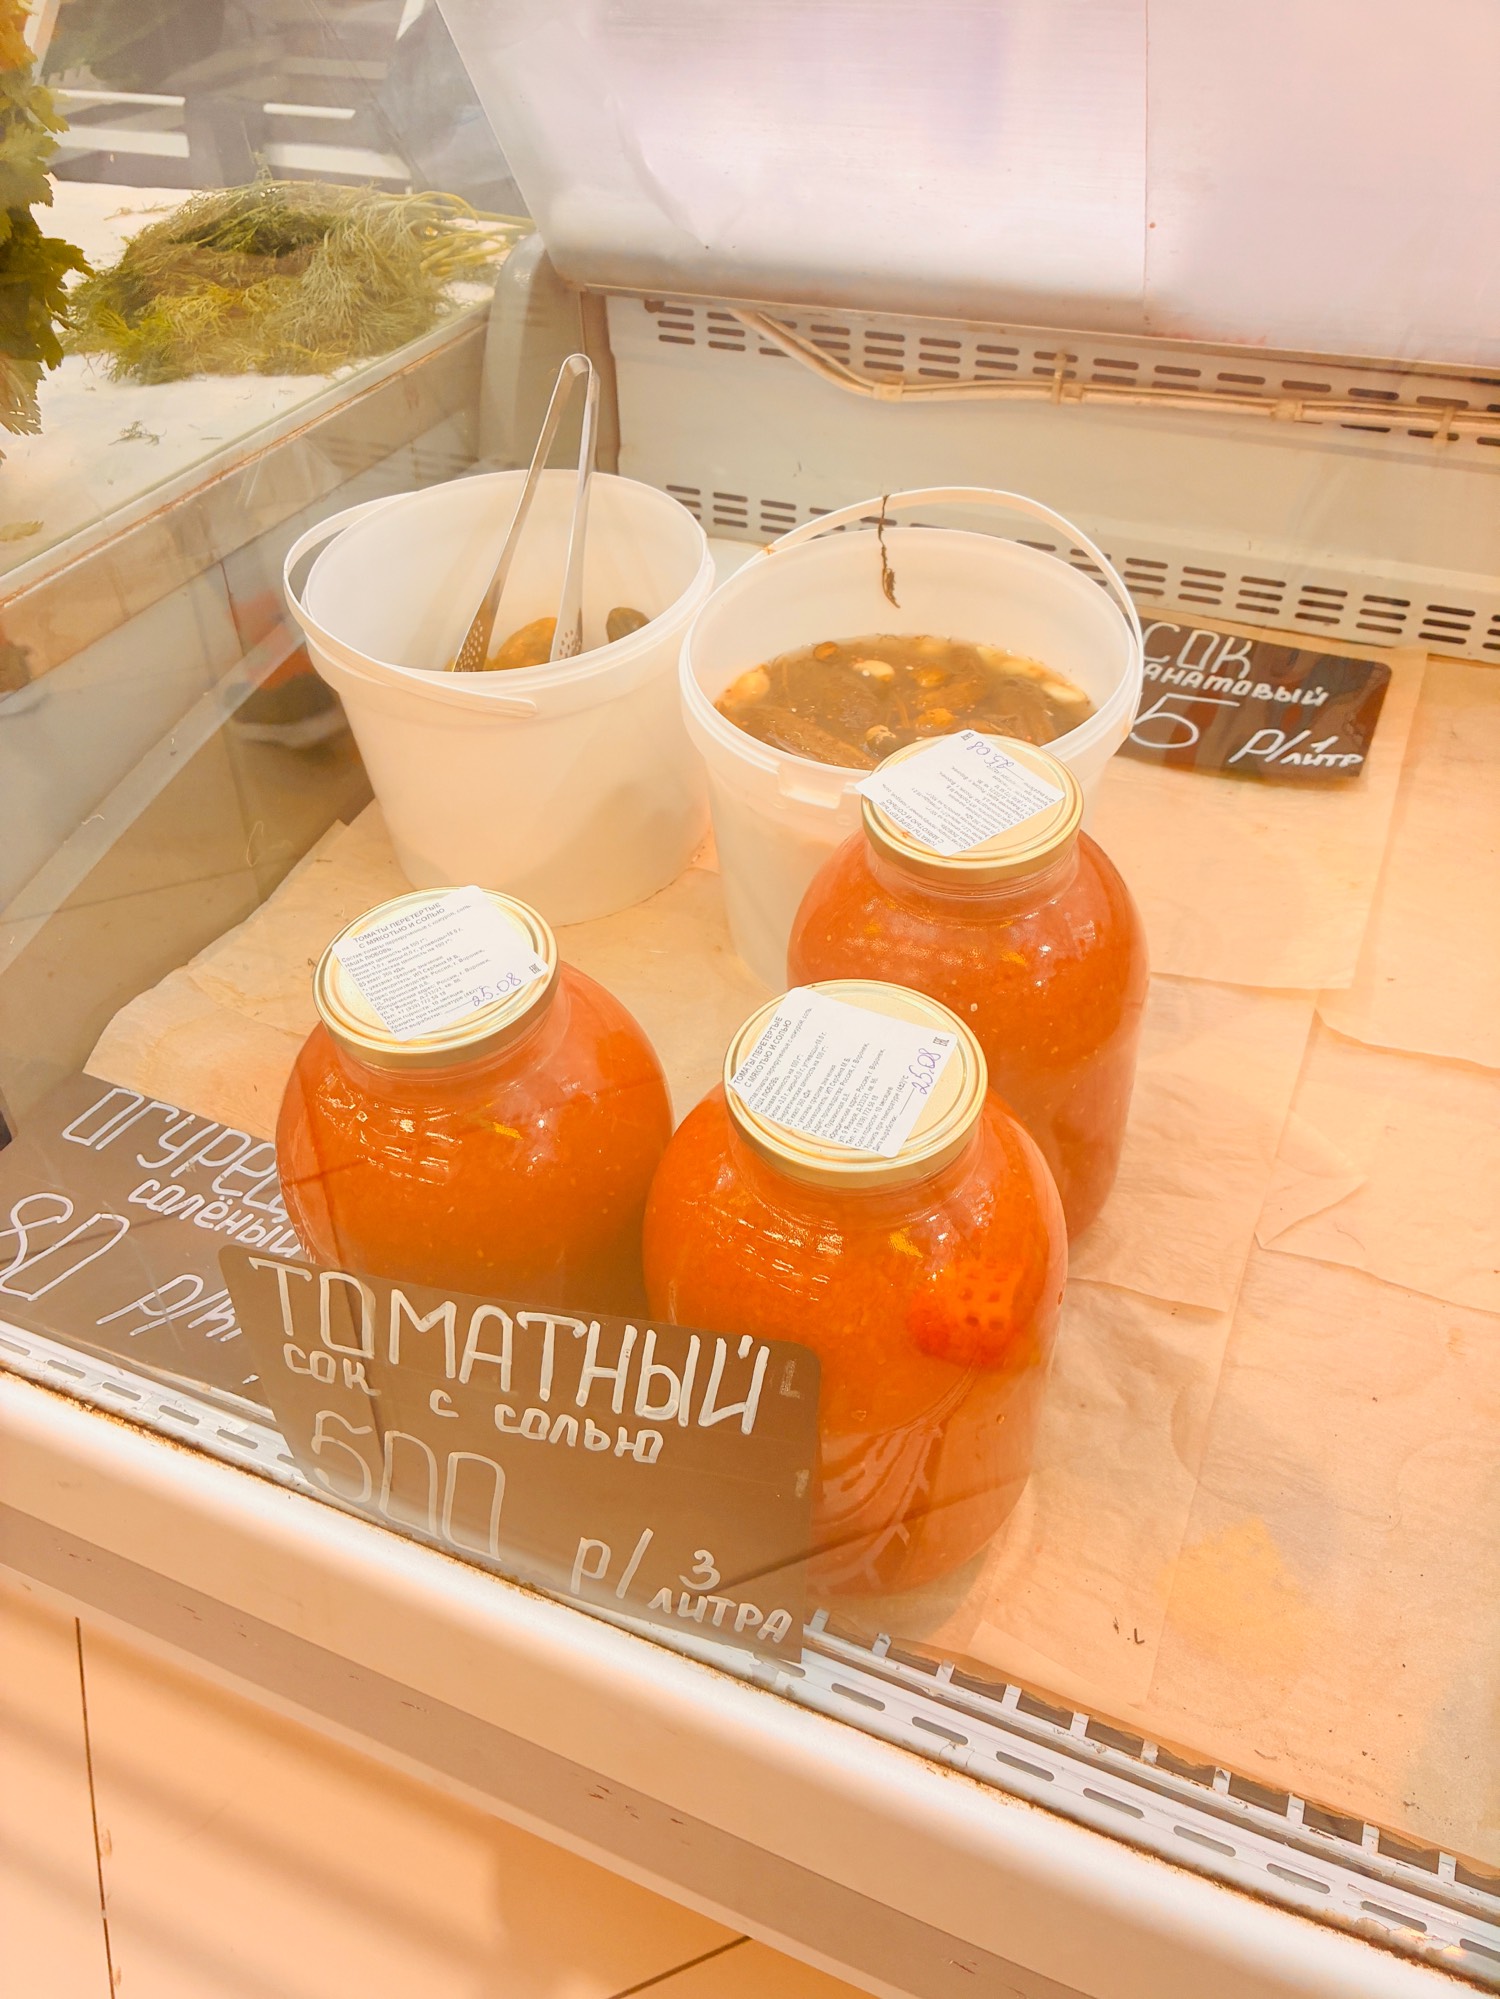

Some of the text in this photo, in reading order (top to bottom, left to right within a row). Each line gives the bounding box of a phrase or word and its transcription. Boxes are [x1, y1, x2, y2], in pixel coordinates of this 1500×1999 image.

[1143, 621, 1253, 678] СОК
[1130, 692, 1240, 749] 5
[353, 901, 441, 944] ТОМАТЫ ПЕРЕТЕРТЫЕ
[365, 924, 408, 946] МЯКОТЬЮ
[414, 907, 446, 924] СОЛЬЮ
[472, 972, 522, 1007] 25.08
[732, 1015, 783, 1085] ТОМАТЫ ПЕРЕТЕРТЫЕ
[746, 1049, 773, 1082] МЯКОТЬЮ
[771, 1019, 792, 1045] СОЛЬЮ
[908, 1047, 942, 1095] 25.08
[96, 1274, 243, 1343] р/к
[248, 1257, 770, 1435] ТОМАТНЫЙ
[310, 1410, 505, 1561] 500
[679, 1549, 721, 1591] 3
